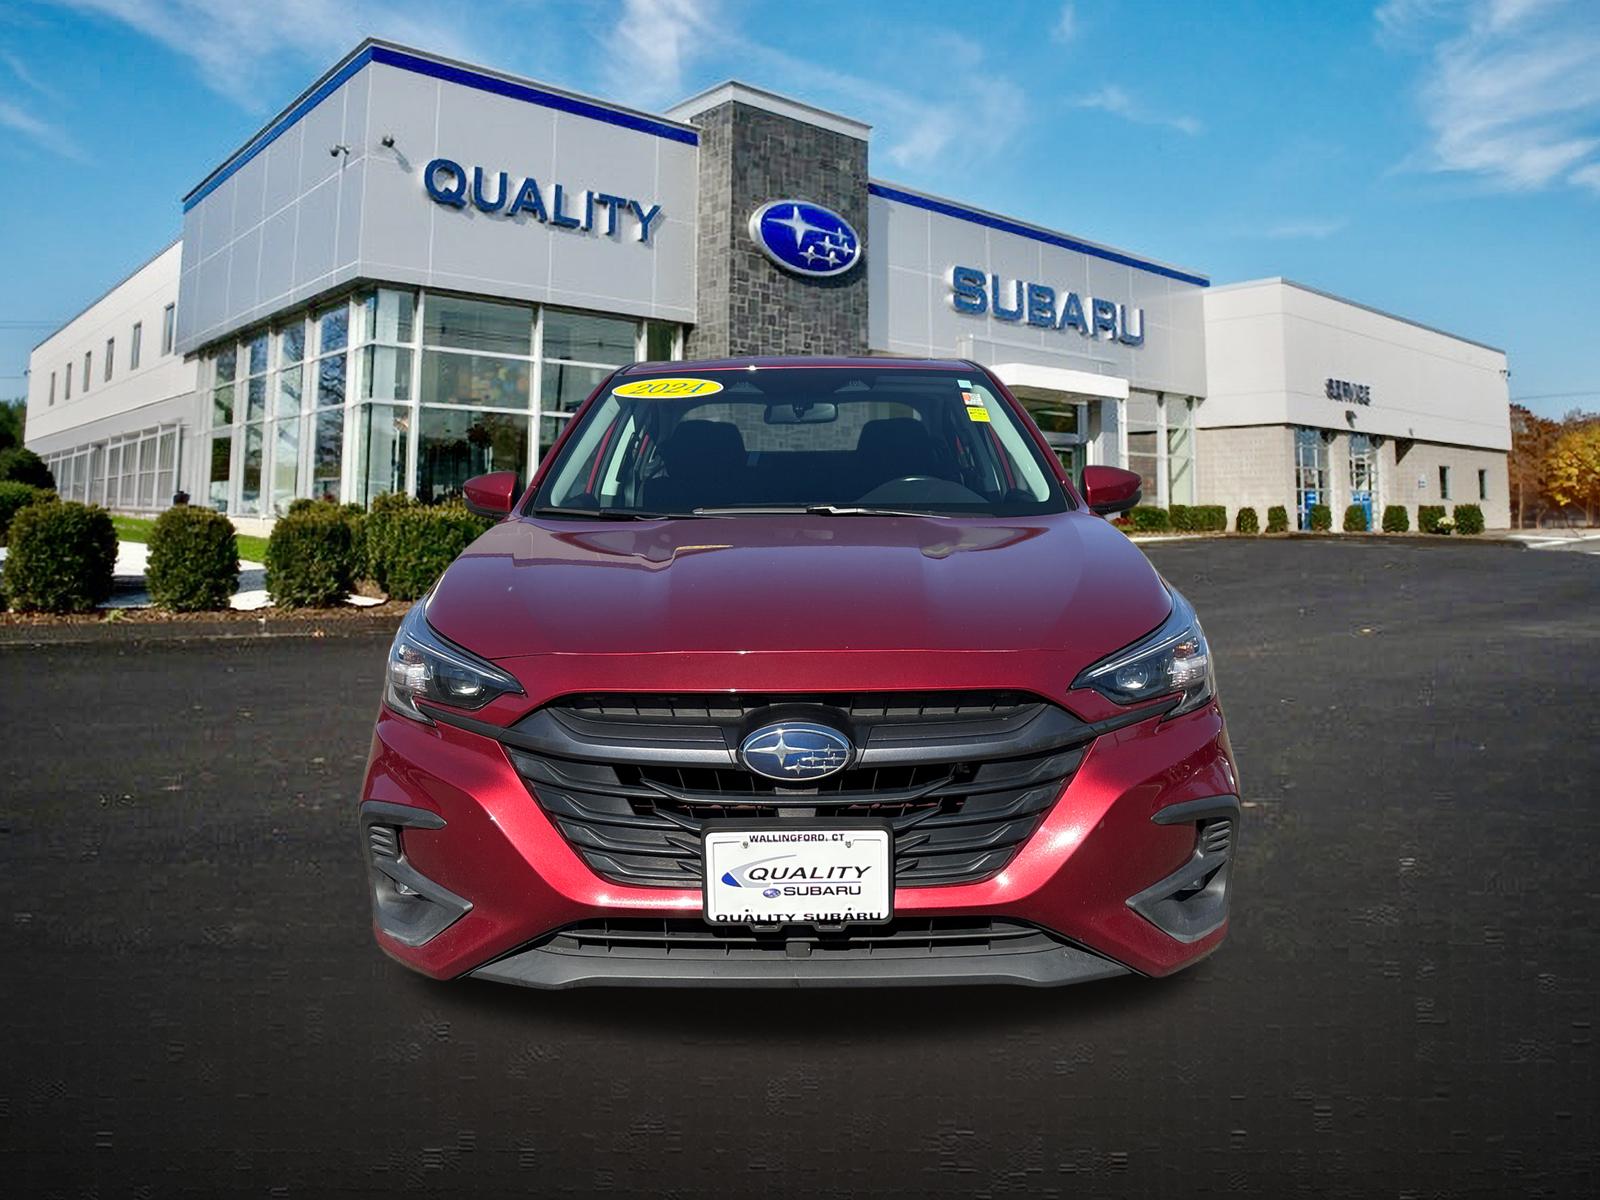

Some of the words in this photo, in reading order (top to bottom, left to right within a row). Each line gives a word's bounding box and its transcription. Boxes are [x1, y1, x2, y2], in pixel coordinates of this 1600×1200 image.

[423, 157, 661, 243] QUALITY
[950, 264, 1145, 347] SUBARU
[628, 382, 706, 395] 2024
[1325, 377, 1371, 406] SERVICE
[831, 833, 845, 842] CT
[748, 865, 873, 881] QUALITY
[783, 886, 862, 896] SUBARU
[715, 913, 796, 923] QUALITY
[803, 911, 882, 922] SUBARU
